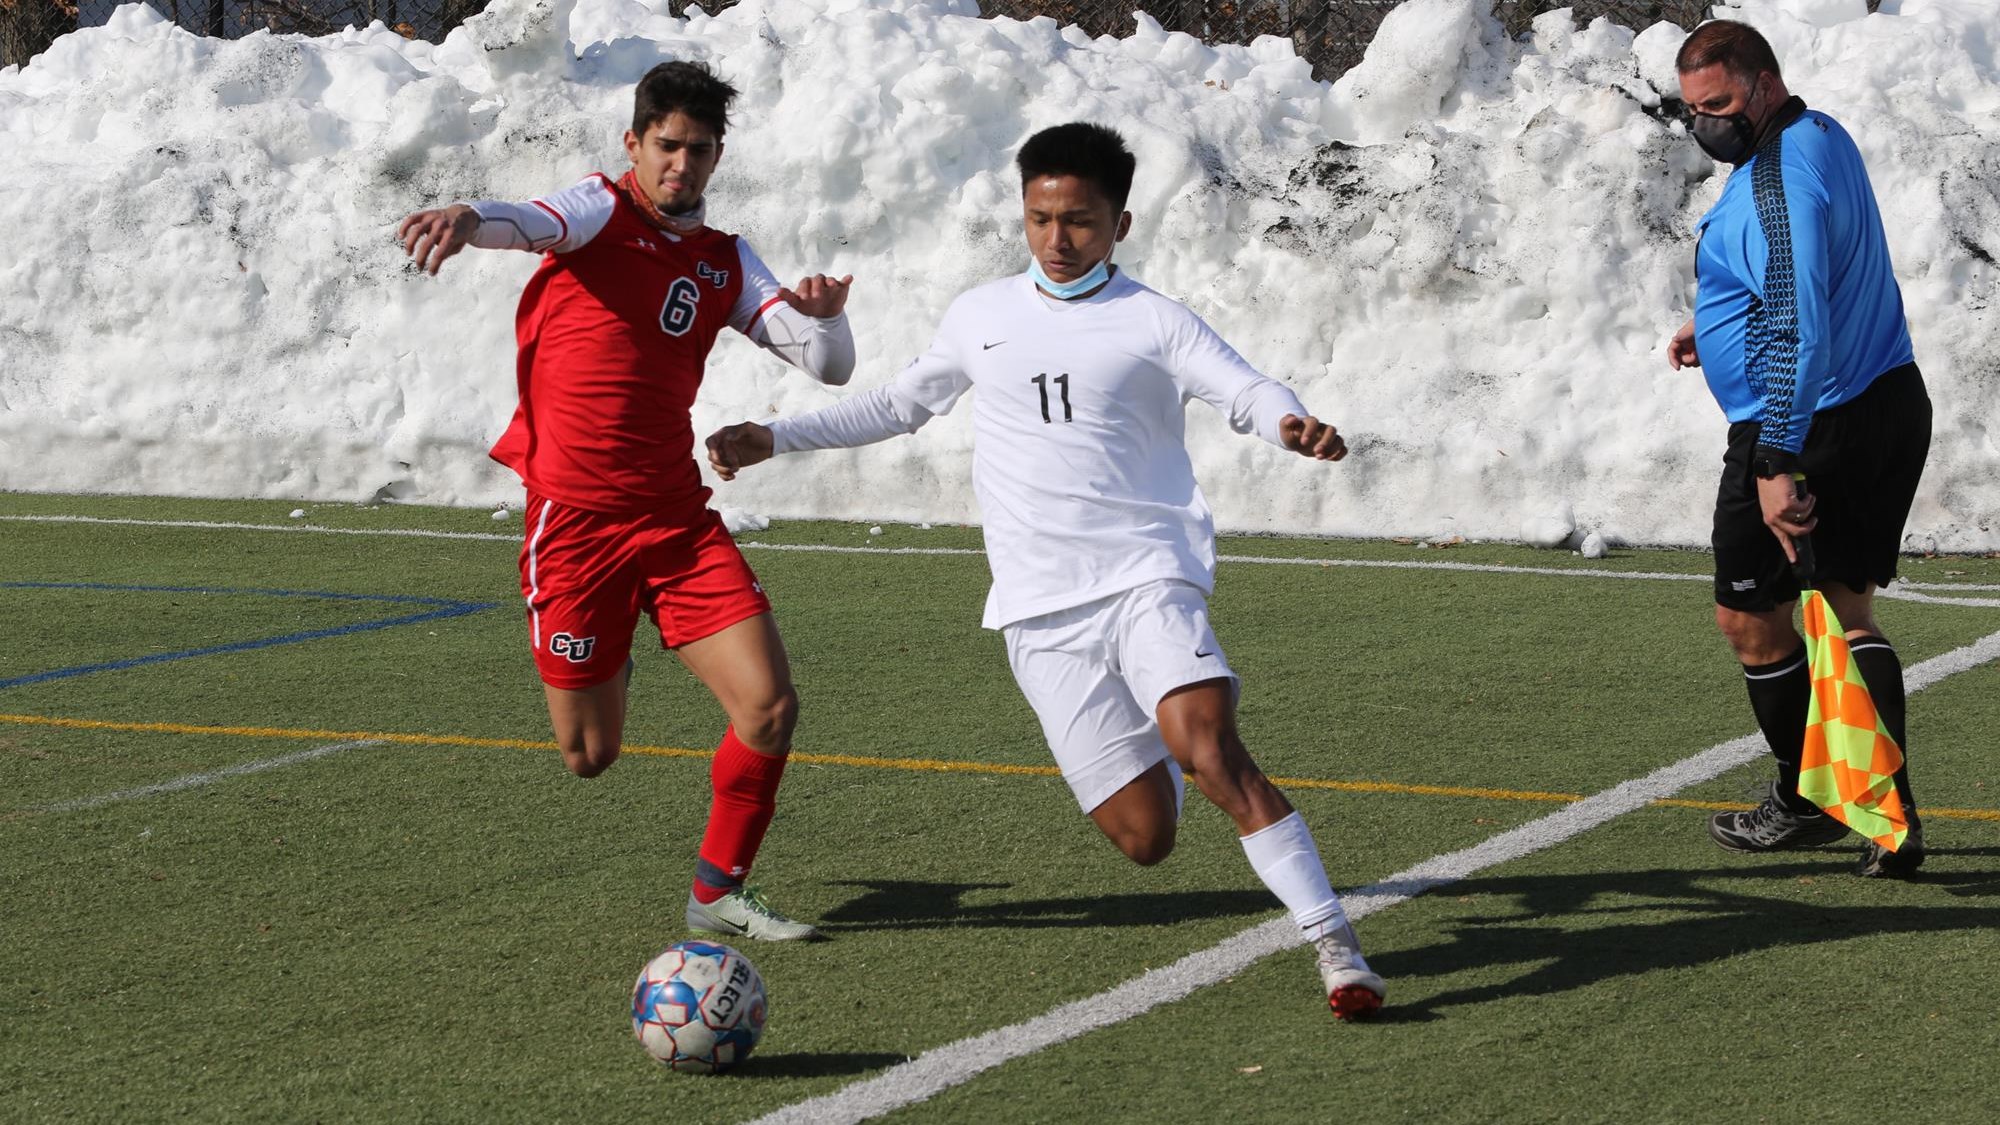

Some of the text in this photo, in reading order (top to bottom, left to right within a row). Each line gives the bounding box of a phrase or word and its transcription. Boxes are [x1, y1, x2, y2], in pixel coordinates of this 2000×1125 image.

[697, 261, 728, 288] CU
[659, 276, 700, 337] 6
[1031, 373, 1072, 424] 11
[549, 632, 596, 663] CU
[710, 959, 750, 1024] SELECT
